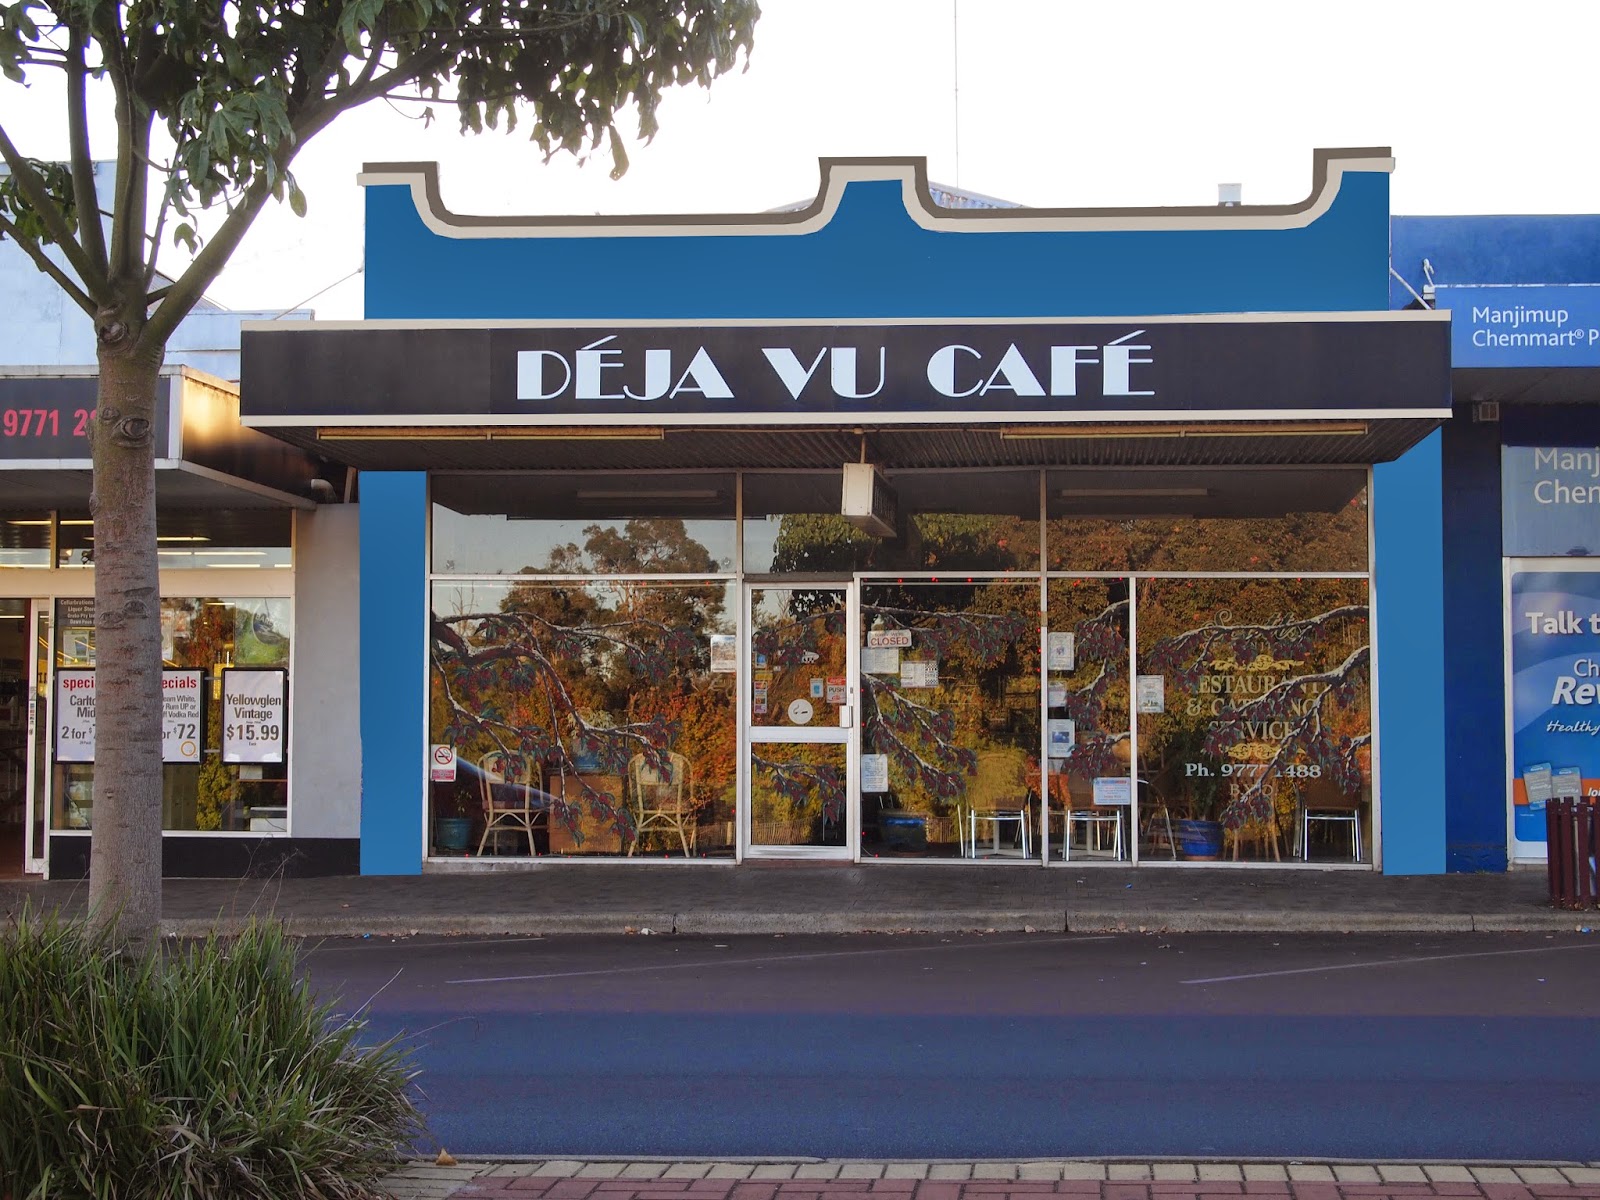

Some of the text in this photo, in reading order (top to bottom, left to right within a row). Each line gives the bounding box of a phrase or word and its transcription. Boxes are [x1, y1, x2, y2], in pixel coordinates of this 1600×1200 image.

[1472, 306, 1569, 328] Manjimup
[517, 330, 1156, 401] DÉJA VU CAFÉ
[3, 409, 97, 437] 9771 2
[1525, 610, 1584, 634] Talk
[870, 636, 909, 646] CLOSED
[63, 676, 95, 691] speci
[162, 676, 197, 688] ecials
[226, 693, 282, 708] Yellowglen
[1186, 698, 1202, 716] &
[233, 707, 273, 721] Vintage
[61, 725, 70, 739] 2
[71, 728, 86, 739] for
[226, 724, 279, 740] $15.99
[1184, 762, 1215, 778] Ph.
